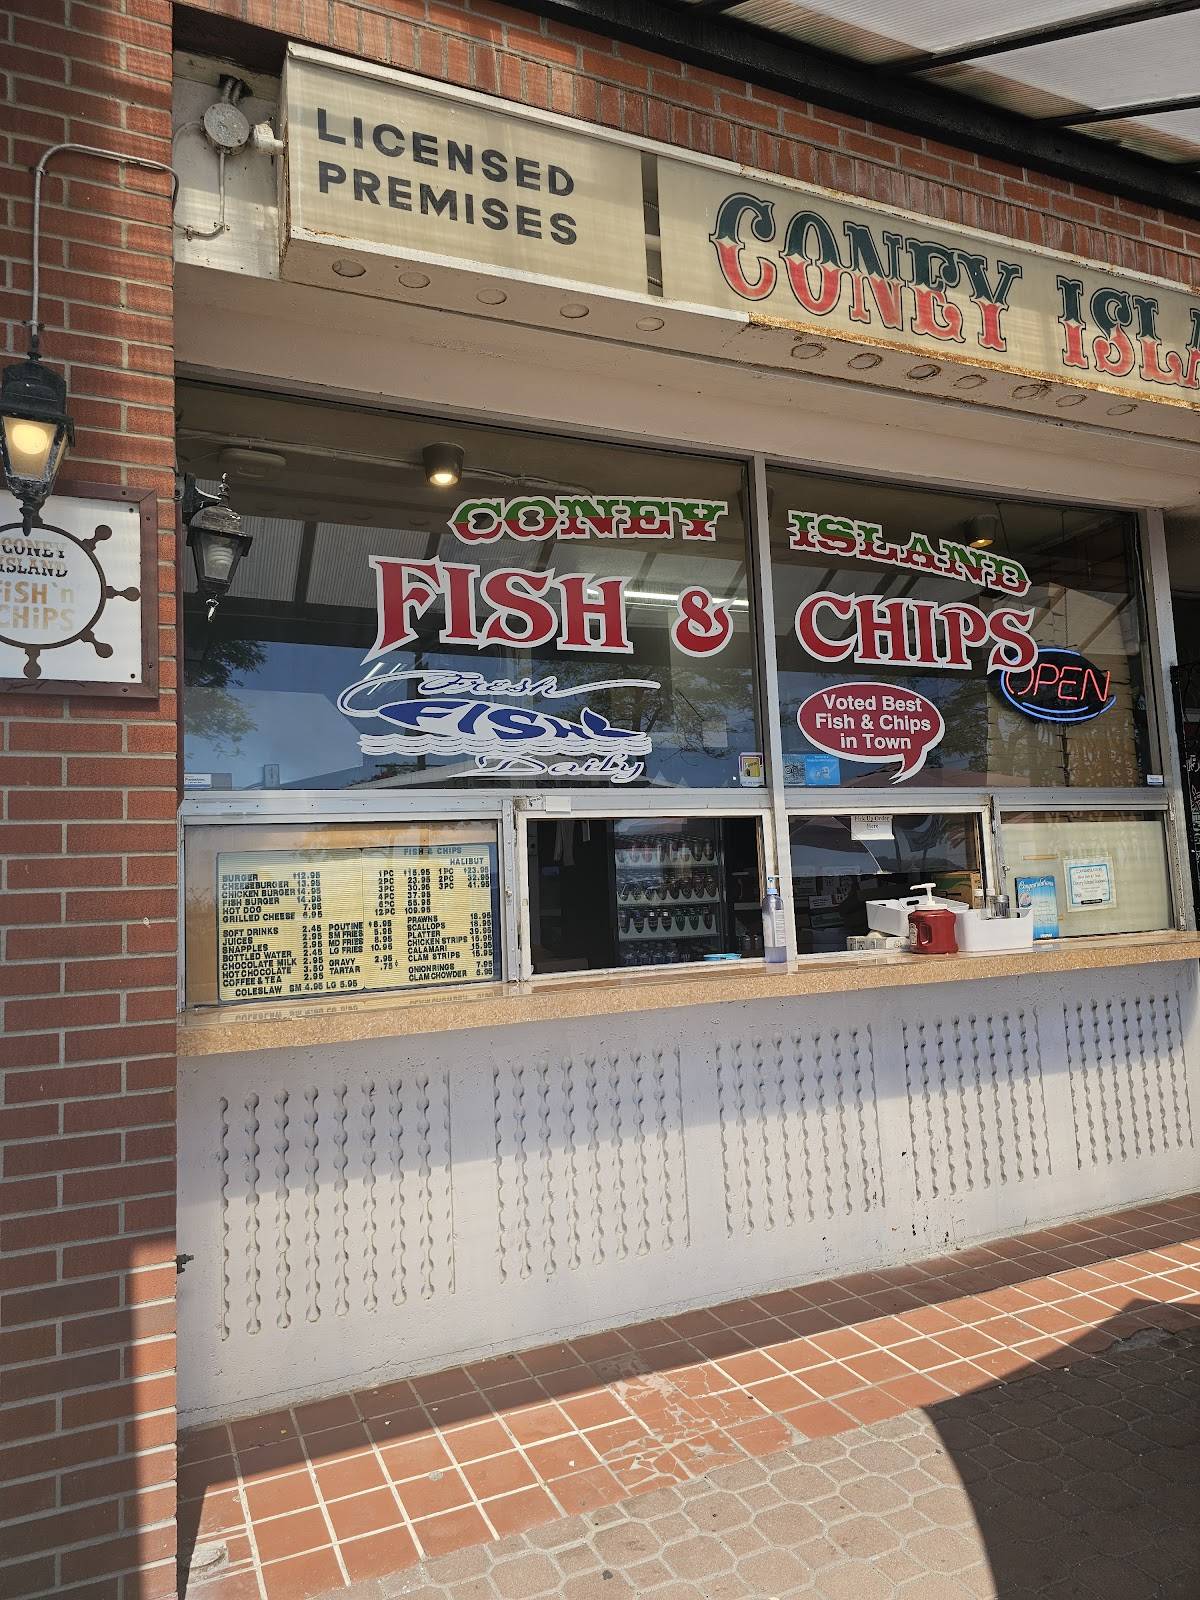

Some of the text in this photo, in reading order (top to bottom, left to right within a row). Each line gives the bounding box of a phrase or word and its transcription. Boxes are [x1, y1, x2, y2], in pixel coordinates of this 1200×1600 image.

[317, 107, 575, 197] LICENSED
[318, 160, 578, 246] PREMISES
[709, 192, 1022, 352] CONEY
[447, 496, 728, 545] CONEY
[2, 538, 66, 559] CONEY
[787, 510, 1033, 597] ISLAND
[361, 555, 738, 665] FISH &
[795, 591, 1038, 674] CHIPS
[1006, 663, 1112, 703] OPEN
[823, 694, 923, 712] Voted Best
[815, 713, 931, 734] Fish & Chips
[840, 733, 911, 749] in Town
[473, 754, 646, 784] Daily
[222, 874, 258, 882] BURGER
[222, 881, 289, 890] CHEESEBURGER
[222, 890, 259, 898] CHICKEN
[262, 888, 295, 897] BURGER
[222, 898, 242, 907] FISH
[245, 897, 279, 906] BURGER
[222, 914, 260, 923] GRILLED
[263, 912, 295, 921] CHEESE
[408, 915, 438, 924] PRAWNS
[247, 927, 279, 936] DRINKS
[329, 922, 363, 930] POUTINE
[407, 922, 446, 931] SCALLOPS
[408, 930, 440, 939] PLATTER
[223, 937, 253, 945] JUICES
[408, 938, 440, 947] CHICKEN
[442, 936, 468, 944] STRIPS
[222, 944, 268, 954] SNAPPLES
[371, 943, 392, 951] 10.95
[408, 945, 447, 954] CALAMARI
[222, 953, 260, 962] BOTTLED
[264, 951, 292, 959] WATER
[432, 952, 460, 960] STRIPS
[222, 960, 273, 970] CHOCOLATE
[277, 958, 297, 966] MILK
[329, 958, 355, 966] GRAVY
[223, 970, 240, 978] HOT
[241, 966, 291, 977] CHOCOLATE
[330, 966, 360, 974] TARTAR
[408, 965, 431, 973] ONION
[432, 963, 454, 971] RINGS
[409, 973, 429, 981] CLAM
[431, 970, 467, 980] CHOWDER
[223, 978, 255, 987] COFFEE
[235, 986, 282, 996] COLESLAW
[289, 984, 301, 992] SM
